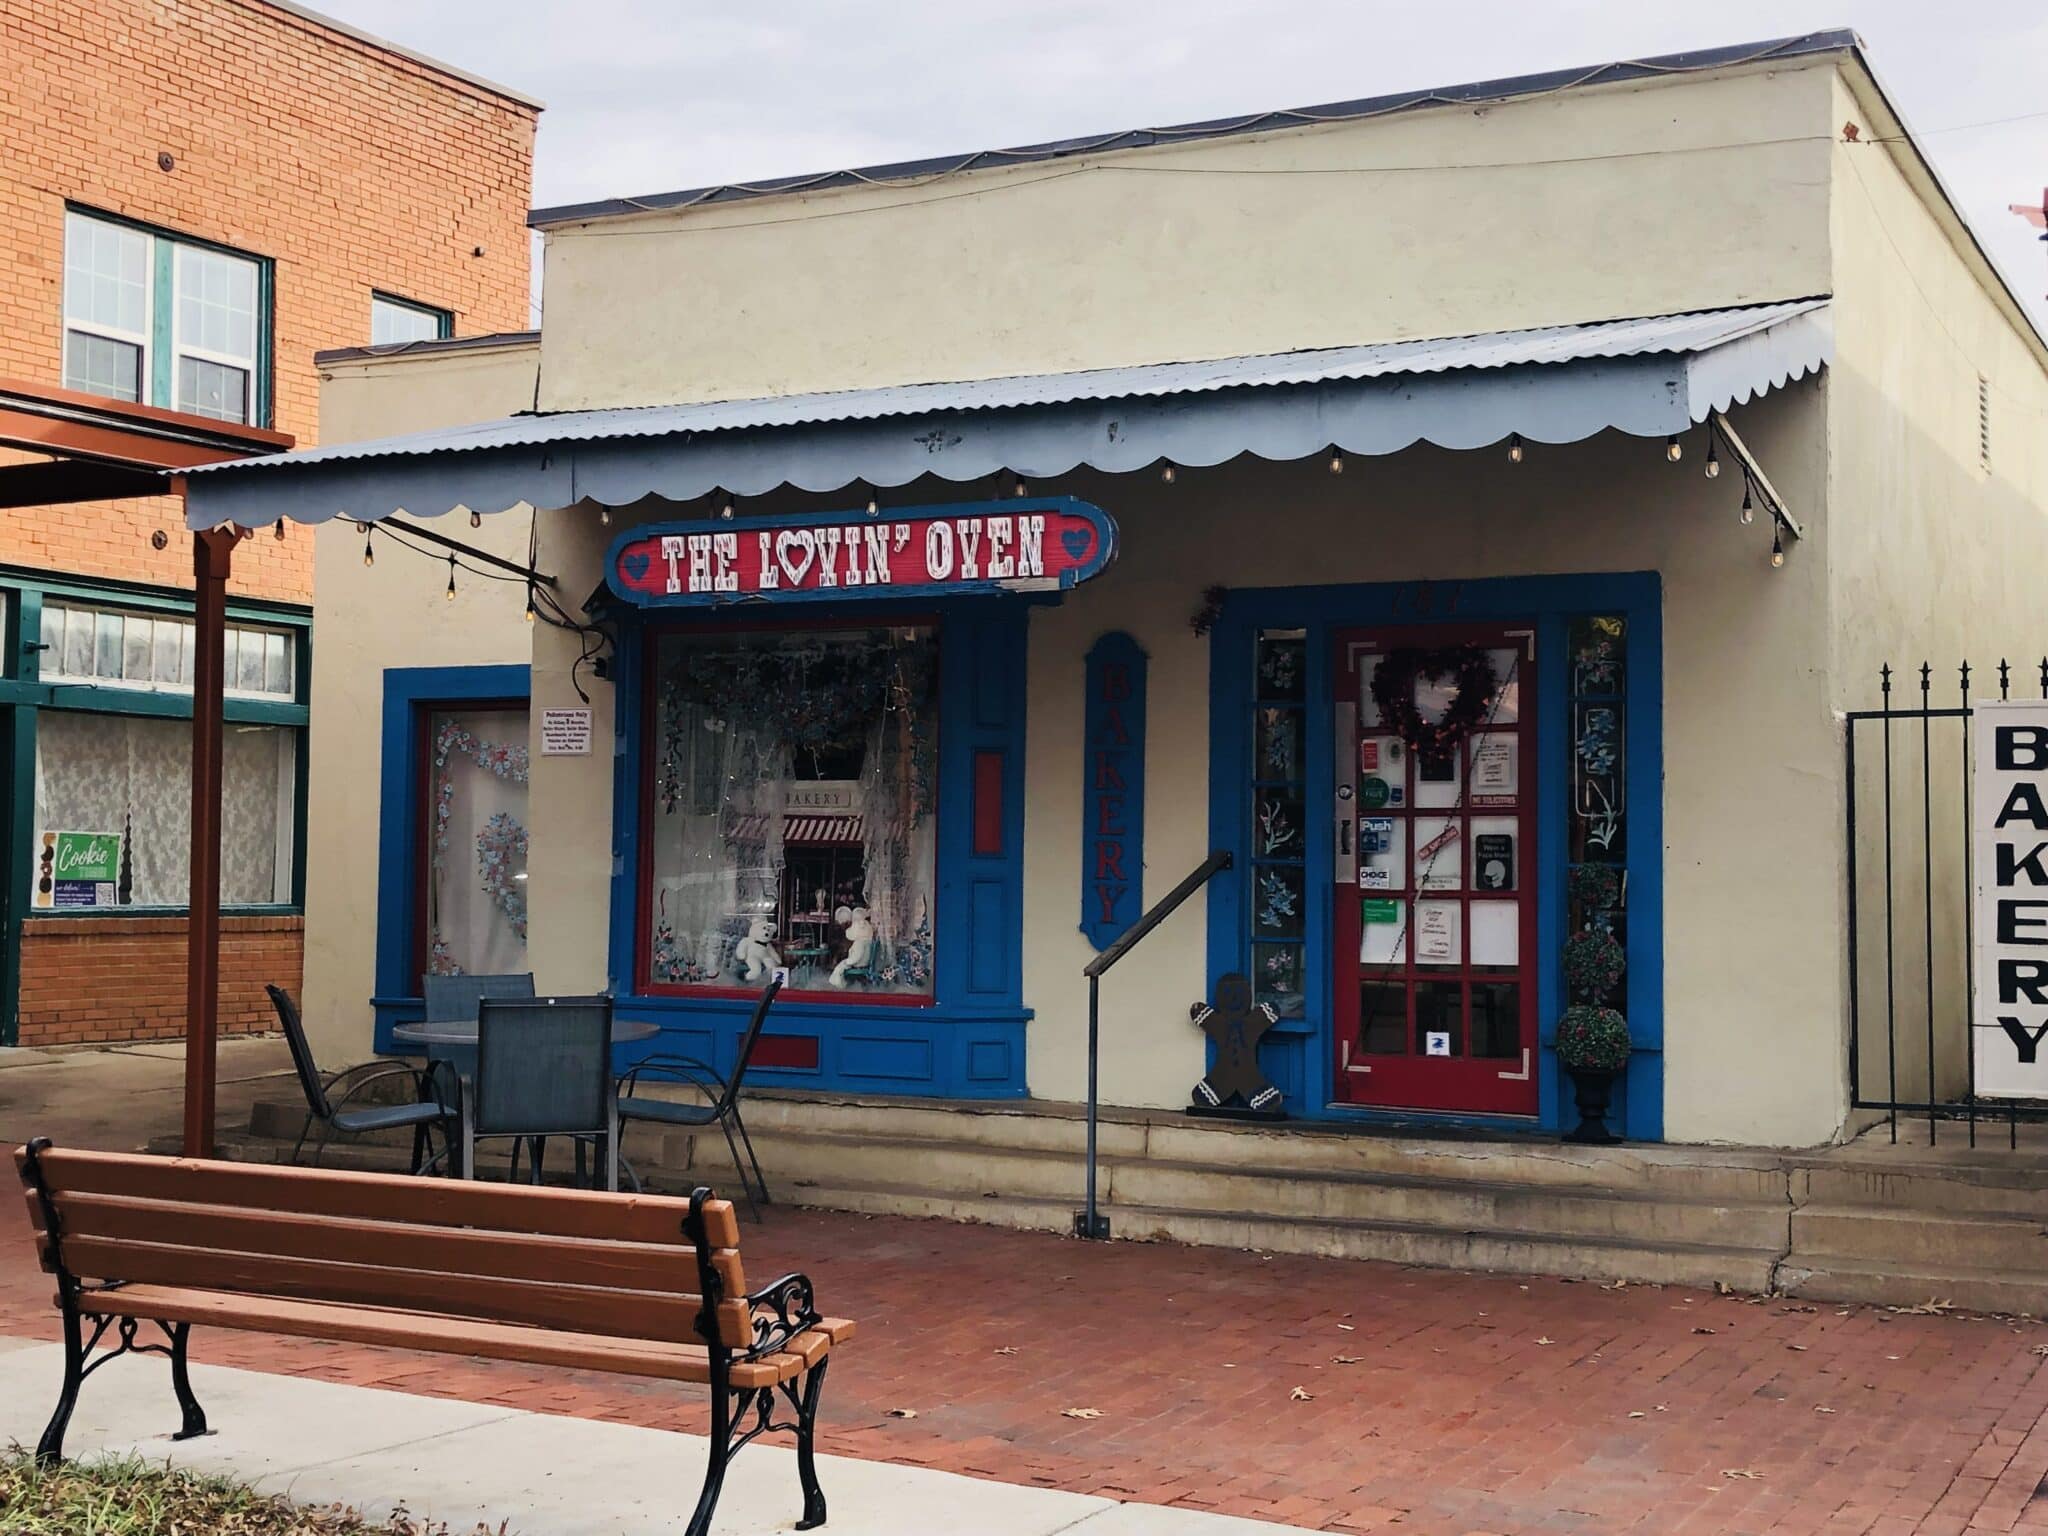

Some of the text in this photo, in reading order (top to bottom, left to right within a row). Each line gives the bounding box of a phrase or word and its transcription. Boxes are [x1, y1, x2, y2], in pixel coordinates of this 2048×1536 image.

[661, 532, 739, 594] THE
[925, 515, 1046, 581] OVEN
[1094, 662, 1131, 924] BAKERY
[1362, 821, 1391, 831] Push
[59, 840, 109, 871] Cookie
[1994, 725, 2048, 1063] BAKERY
